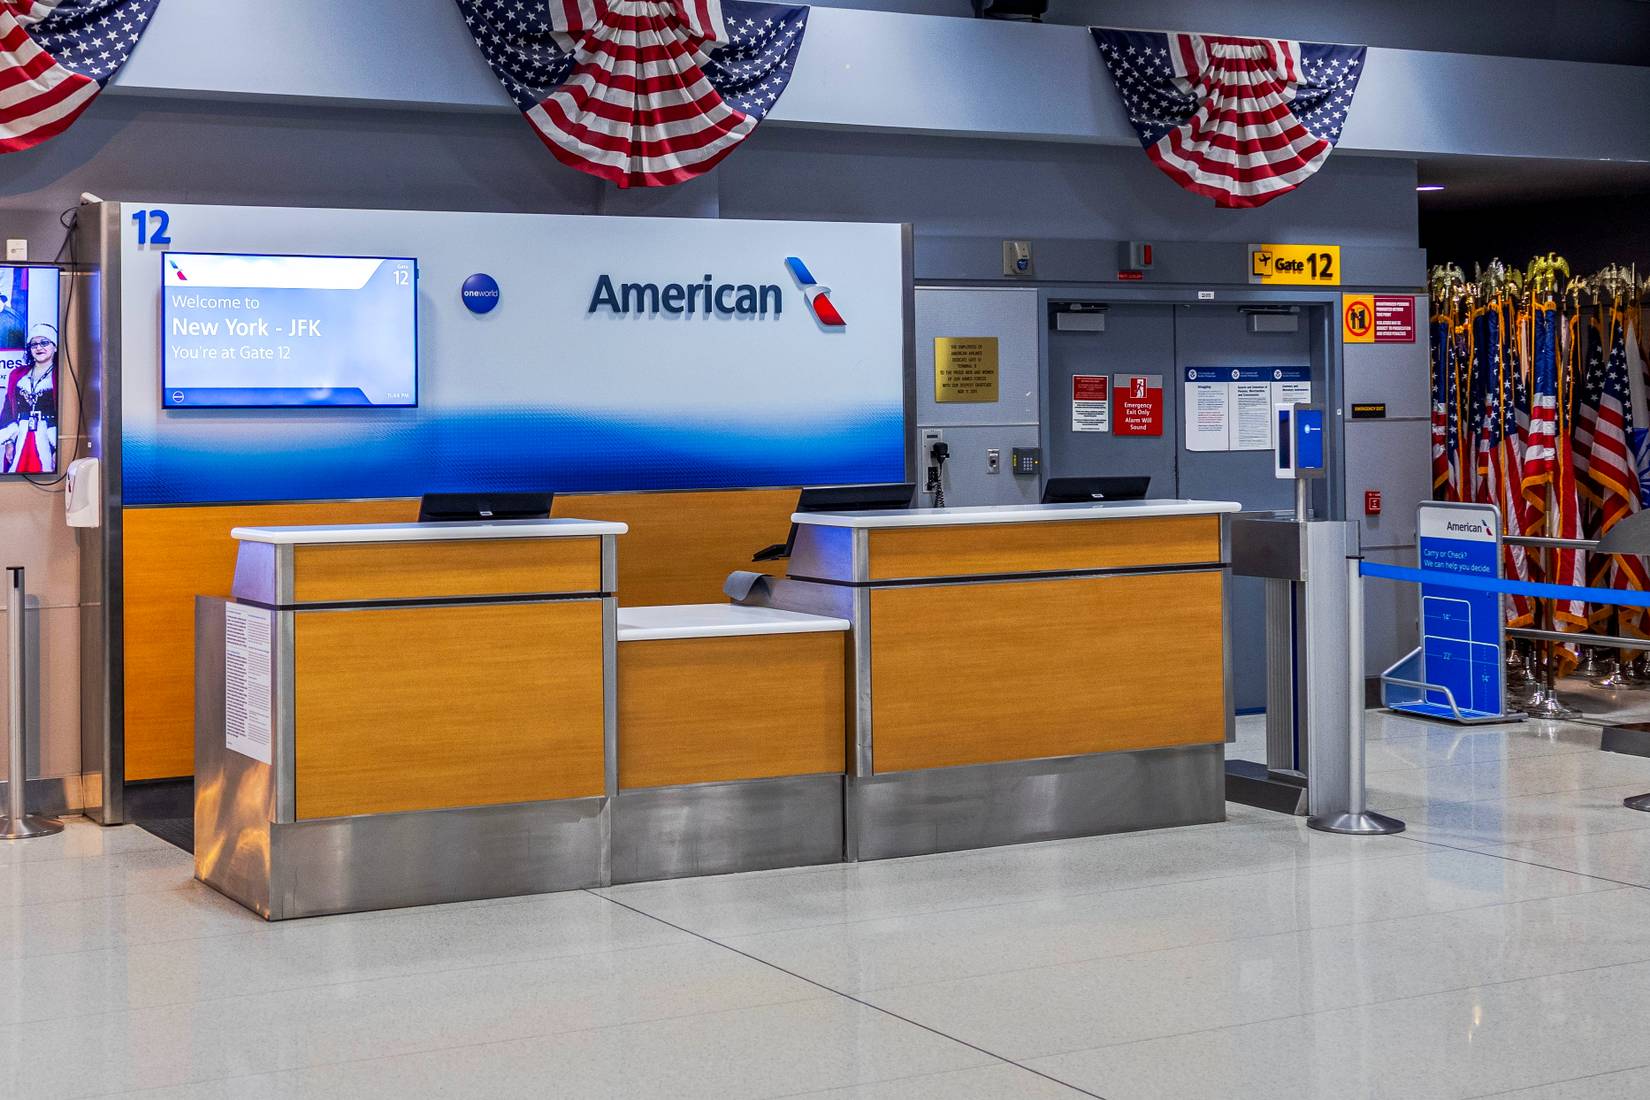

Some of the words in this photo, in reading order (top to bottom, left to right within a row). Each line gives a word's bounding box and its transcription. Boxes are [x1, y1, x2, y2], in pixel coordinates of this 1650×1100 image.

[132, 209, 171, 245] 12
[1274, 257, 1304, 272] Gate
[1307, 253, 1334, 278] 12
[393, 270, 409, 285] 12
[463, 289, 499, 298] oneworld
[588, 273, 783, 314] American
[172, 295, 241, 309] Welcome
[245, 297, 260, 309] to
[172, 317, 219, 336] New
[225, 317, 269, 337] York
[288, 319, 322, 337] JFK
[172, 345, 217, 360] You're
[221, 346, 236, 360] at
[240, 345, 274, 360] Gate
[277, 346, 291, 360] 12
[1124, 401, 1153, 410] Emergency
[1446, 521, 1482, 533] American
[1423, 548, 1440, 559] Carry
[1447, 550, 1468, 559] Check?
[1423, 559, 1434, 567] We
[1445, 561, 1458, 570] help
[1459, 564, 1470, 572] you
